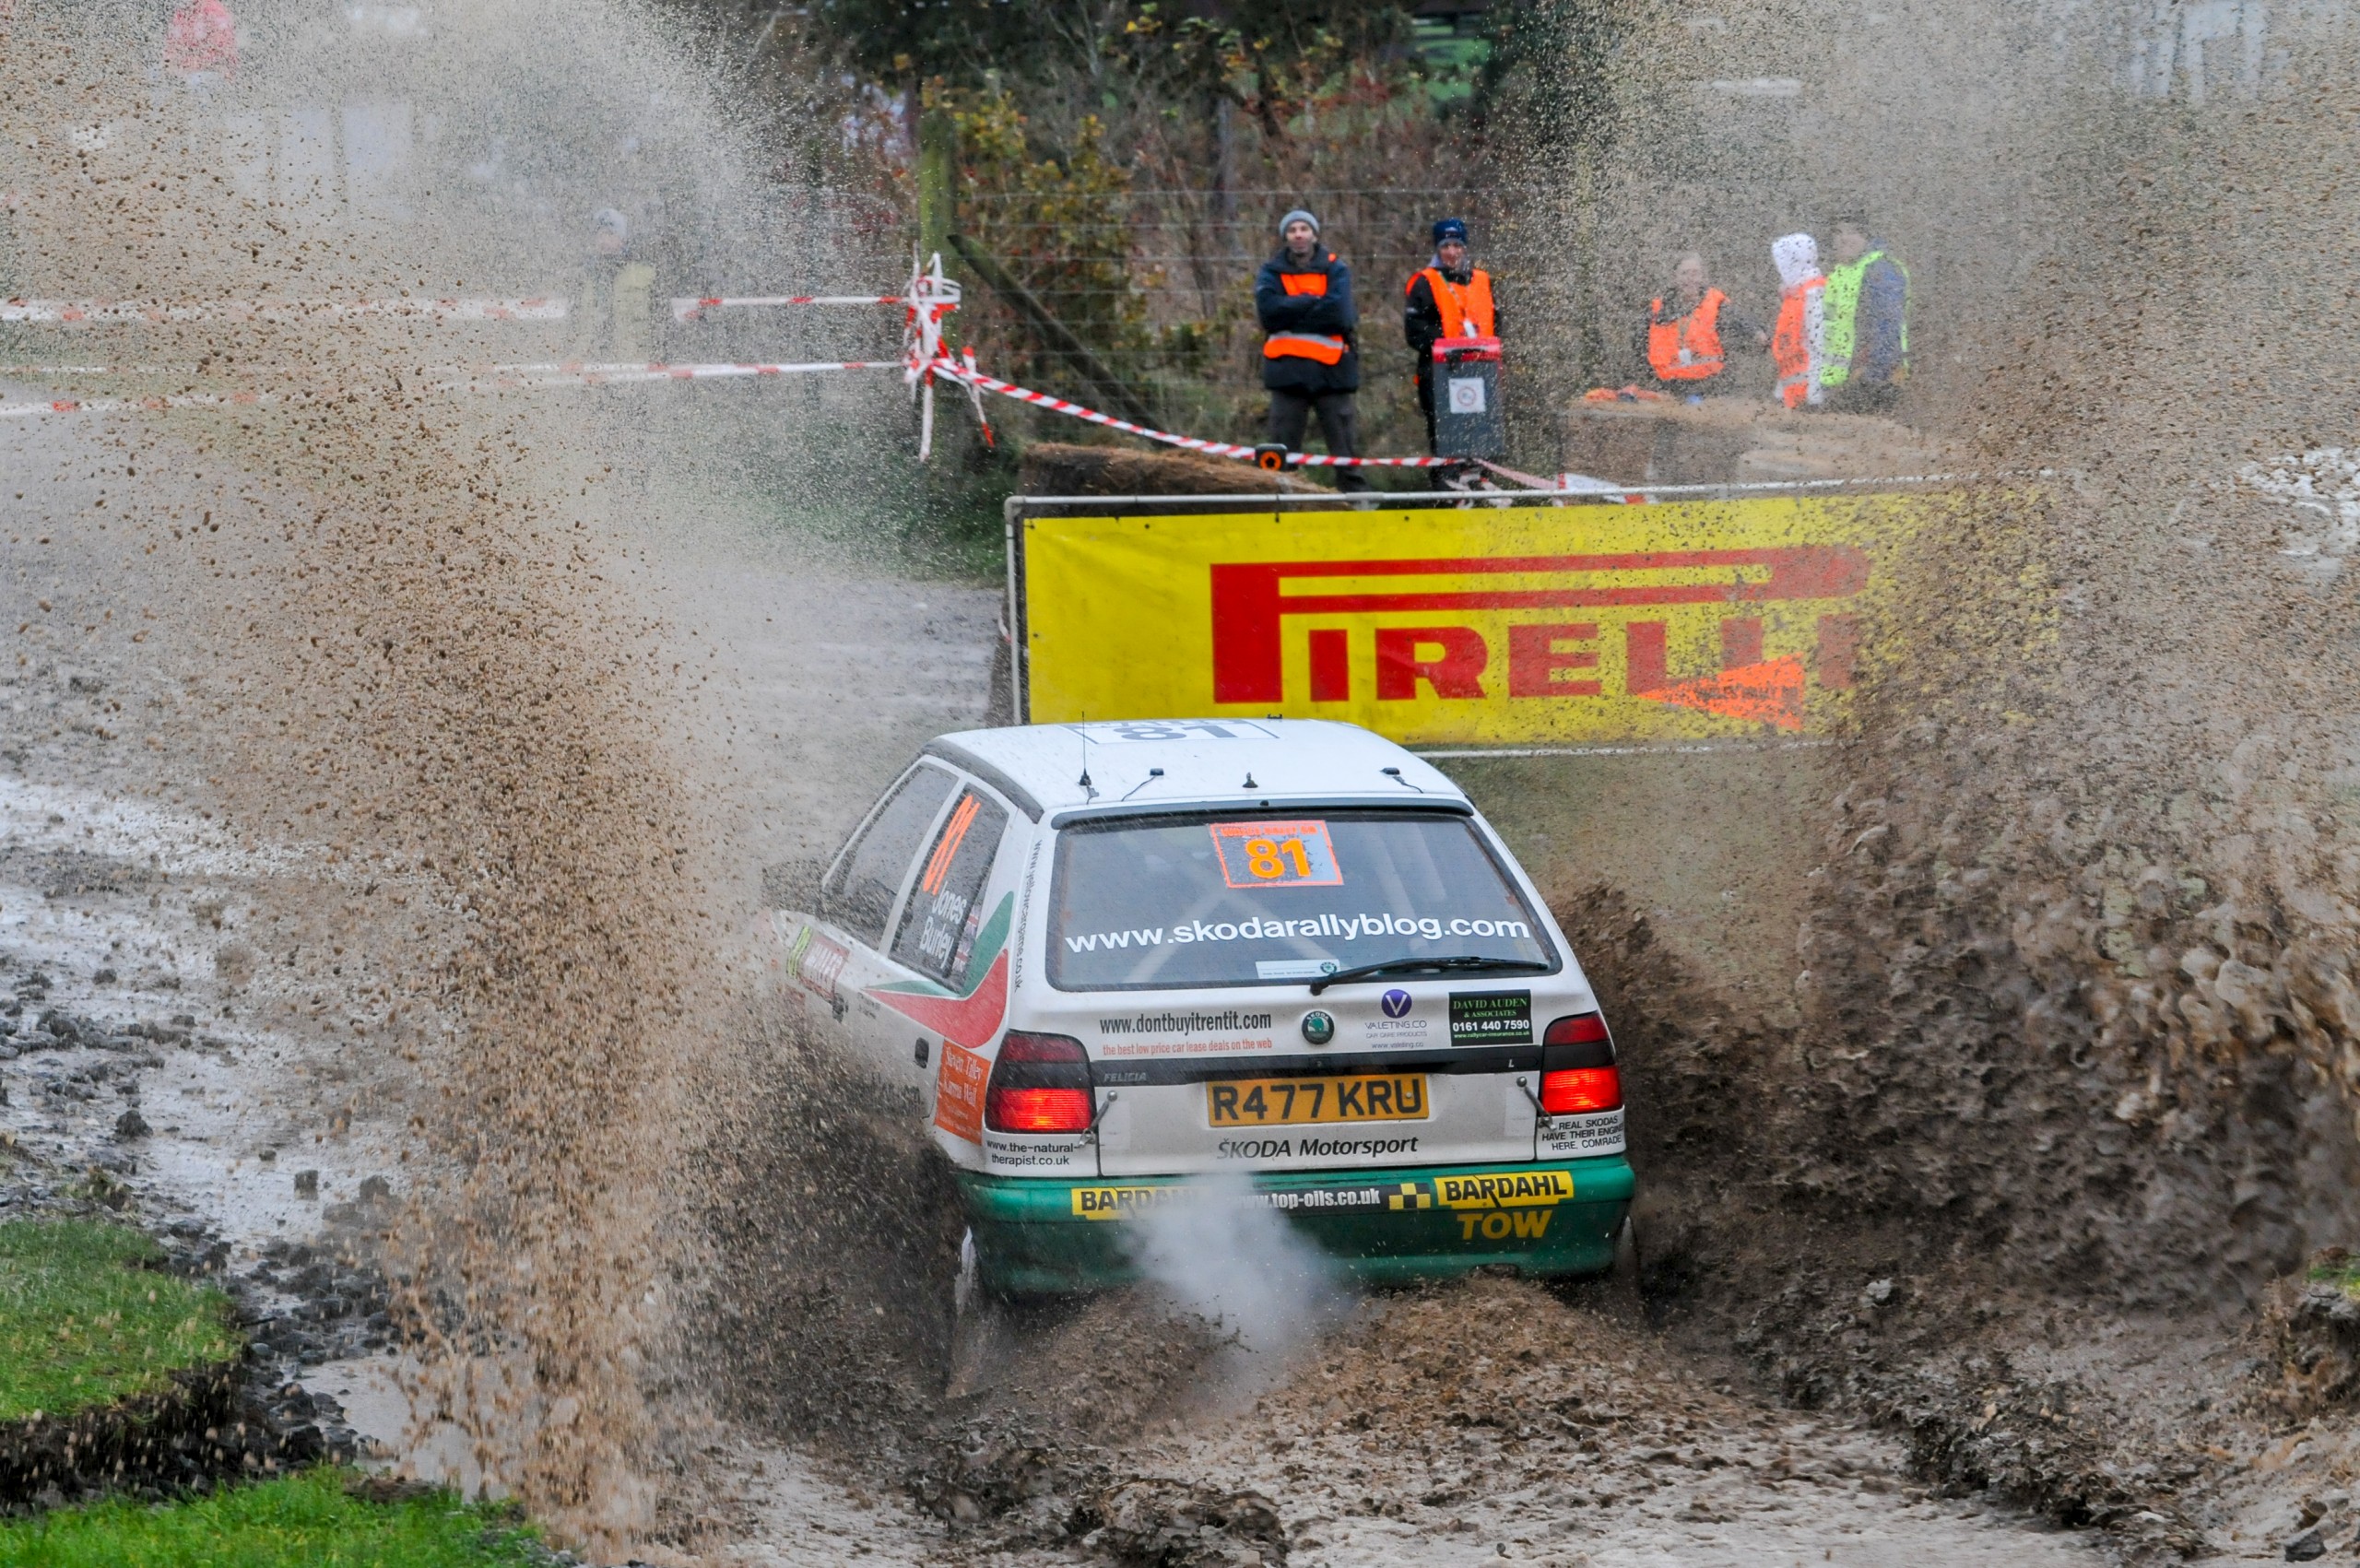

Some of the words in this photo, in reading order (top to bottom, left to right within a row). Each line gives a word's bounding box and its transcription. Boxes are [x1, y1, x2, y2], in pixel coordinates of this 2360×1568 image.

[1210, 545, 1872, 703] PIRELLI
[1245, 837, 1312, 878] 81
[932, 880, 967, 925] Jones
[919, 916, 954, 969] Burley
[1065, 914, 1530, 953] www.skodarallyblog.com
[1453, 999, 1487, 1010] DAVID
[1490, 997, 1528, 1008] AUDEN
[1472, 1009, 1516, 1018] ASSOCIATES
[1100, 1011, 1271, 1036] www.dontbuyitrentit.com
[1452, 1021, 1478, 1032] 0161
[1481, 1020, 1502, 1032] 440
[1504, 1019, 1530, 1030] 7590
[1103, 1044, 1116, 1055] the
[1117, 1043, 1135, 1055] best
[1136, 1043, 1150, 1054] low
[1150, 1043, 1171, 1055] price
[1172, 1043, 1185, 1053] car
[1186, 1041, 1207, 1052] lease
[1209, 1040, 1230, 1051] deals
[1231, 1041, 1241, 1050] on
[1242, 1038, 1255, 1049] the
[1256, 1038, 1272, 1049] web
[1508, 1059, 1515, 1067] L
[1103, 1072, 1147, 1082] FELICIA
[1212, 1083, 1325, 1120] R477
[1337, 1079, 1422, 1116] KRU
[1559, 1121, 1582, 1130] REAL
[1586, 1115, 1618, 1127] SKODAS
[1542, 1131, 1565, 1141] HAVE
[1570, 1127, 1595, 1138] THEIR
[1582, 1135, 1622, 1149] COMRADE
[1217, 1138, 1292, 1159] ŠKODA
[1299, 1137, 1419, 1157] Motorsport
[992, 1154, 1069, 1167] therapist.co.uk
[1445, 1175, 1567, 1202] BARDAHL
[1457, 1209, 1552, 1240] TOW
